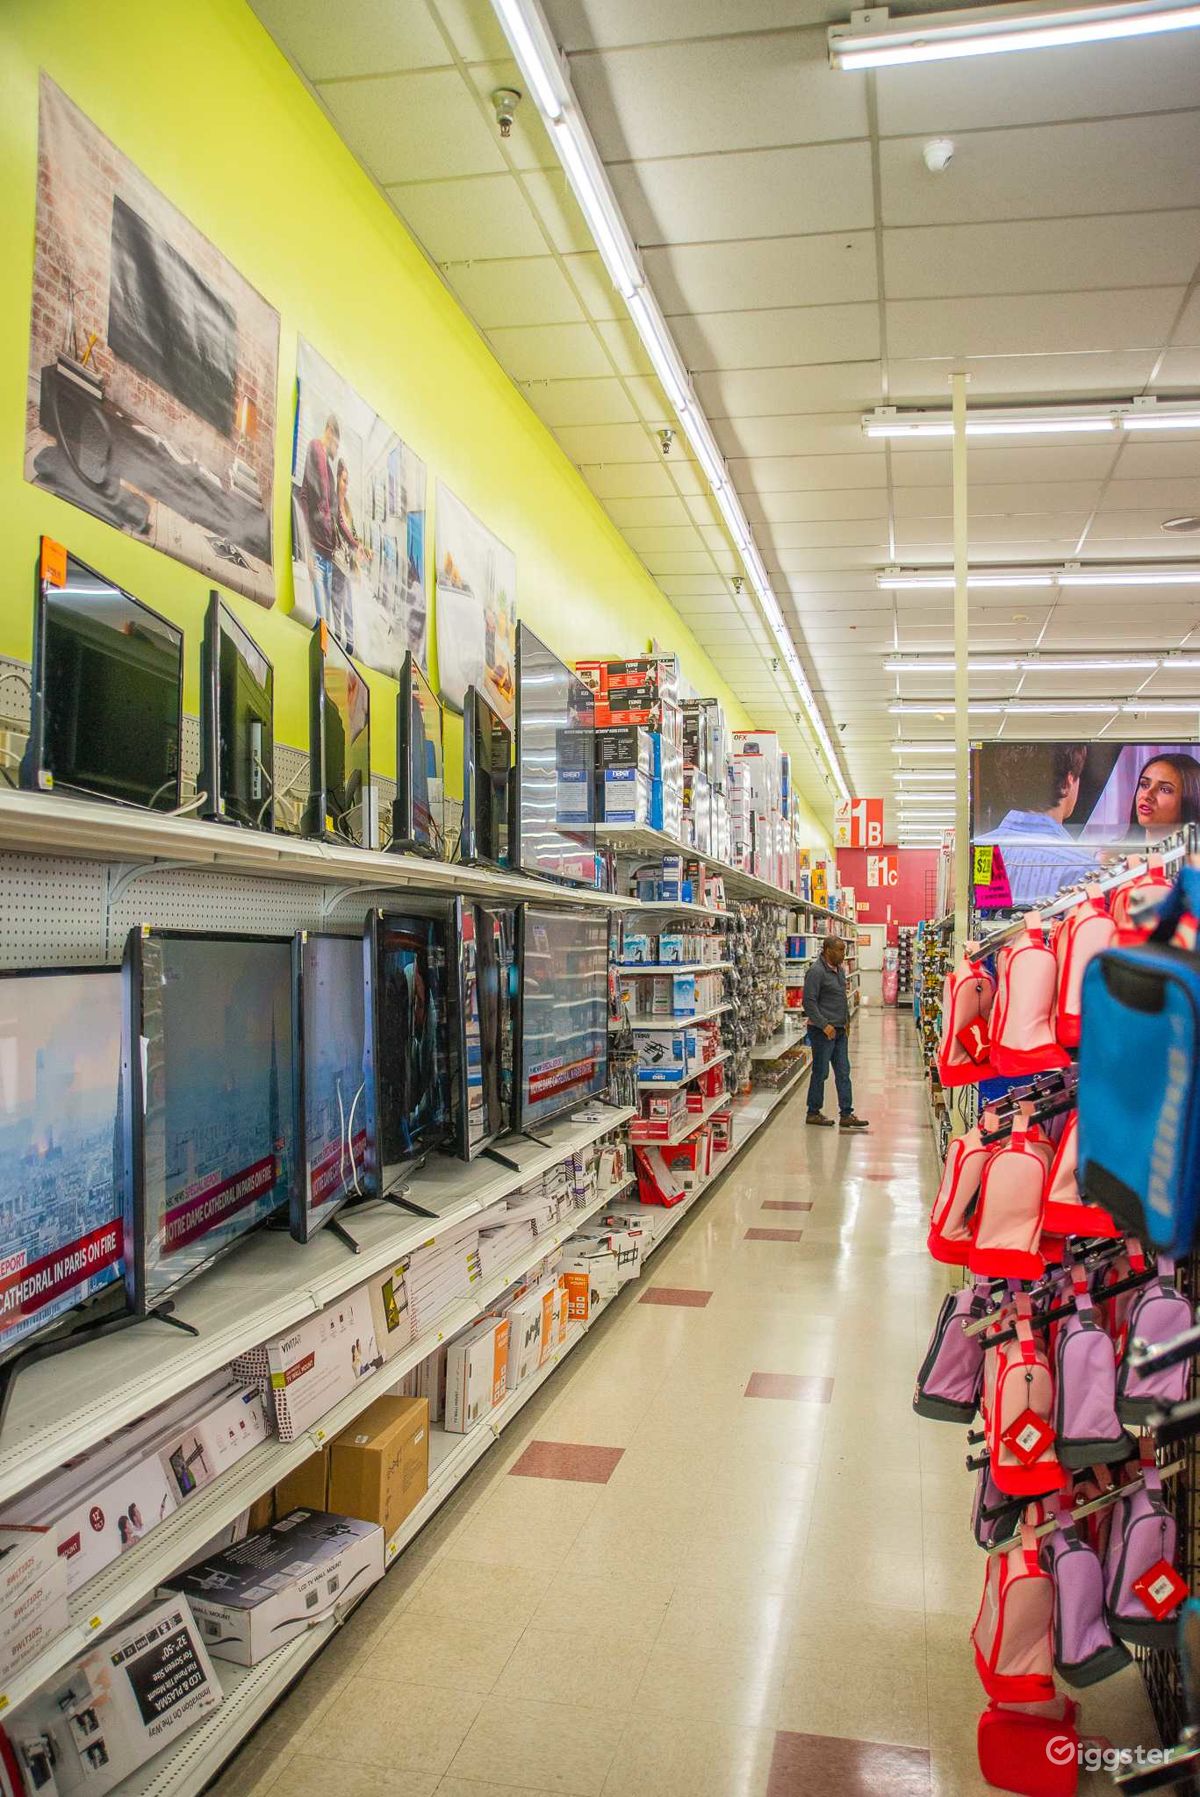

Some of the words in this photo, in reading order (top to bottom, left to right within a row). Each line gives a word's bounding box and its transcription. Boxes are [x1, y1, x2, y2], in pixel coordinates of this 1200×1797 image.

[186, 1205, 204, 1231] DAME
[204, 1186, 236, 1219] CATHEDRAL
[0, 1251, 26, 1277] EPORT
[54, 1261, 64, 1283] IN
[64, 1248, 87, 1277] PARIS
[87, 1240, 100, 1262] ON
[101, 1231, 116, 1256] FIRE
[182, 1649, 193, 1661] For
[163, 1655, 184, 1674] Screen
[152, 1669, 165, 1682] Size
[189, 1672, 202, 1686] LCD
[183, 1681, 190, 1691] &
[155, 1685, 183, 1711] PLASMA
[181, 1687, 211, 1715] Innovation
[162, 1714, 174, 1727] The
[172, 1708, 182, 1720] On
